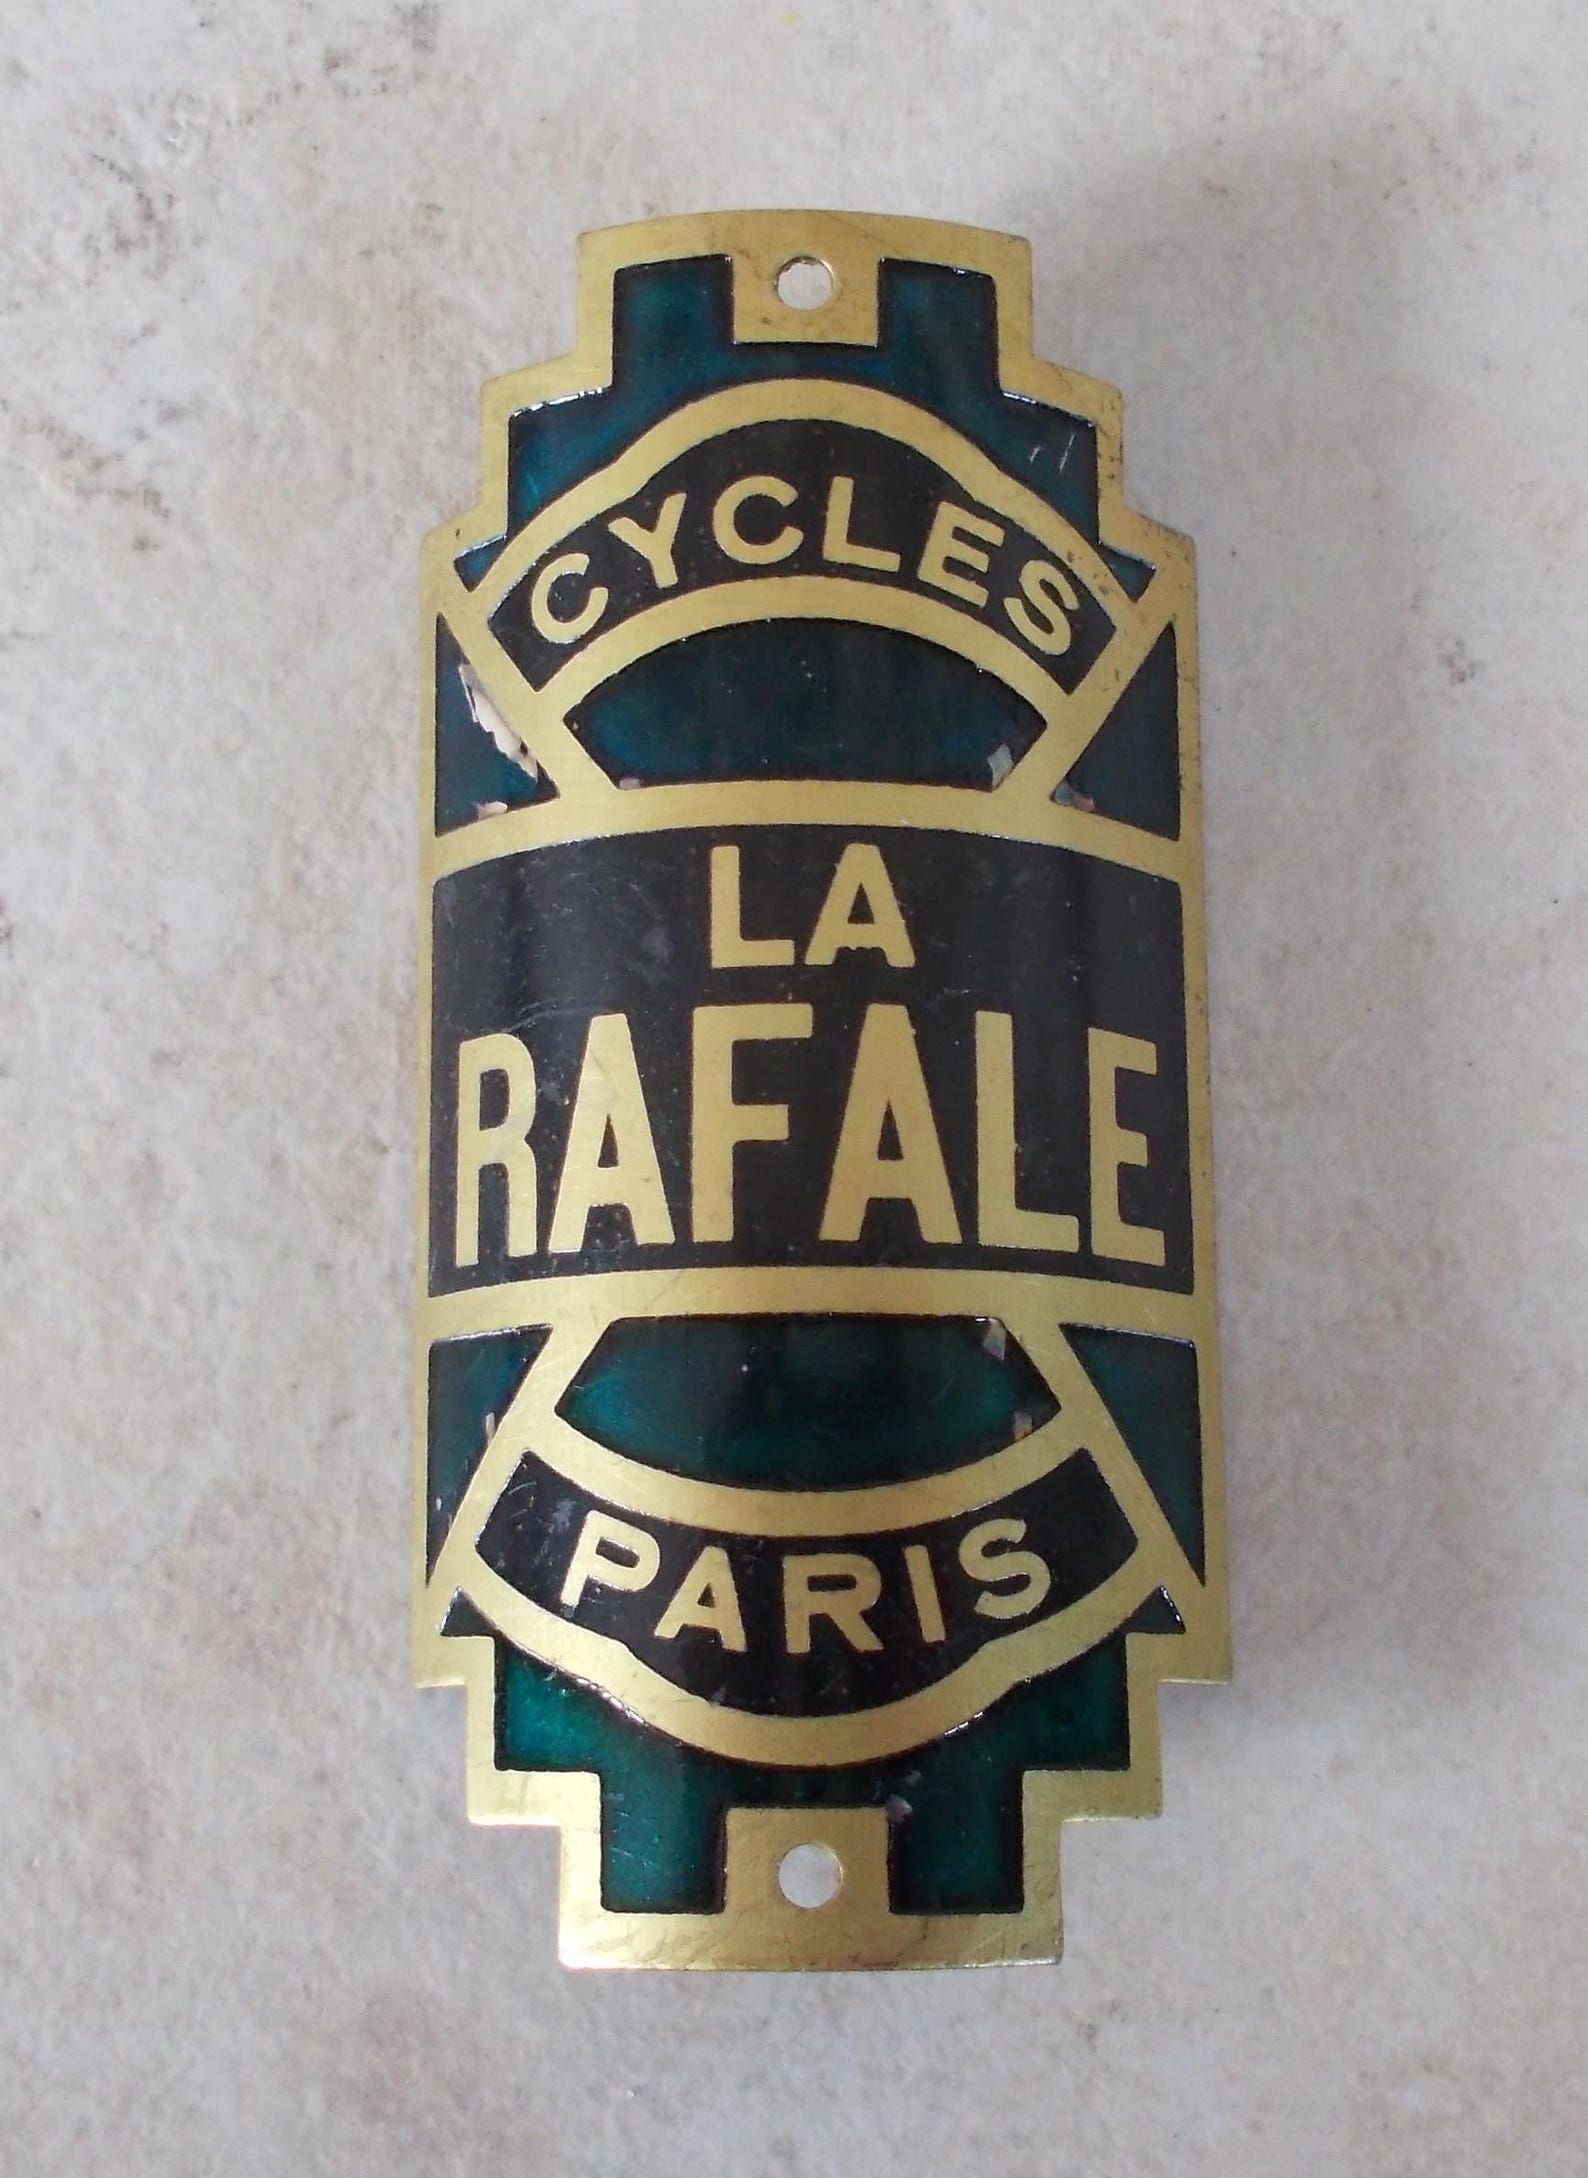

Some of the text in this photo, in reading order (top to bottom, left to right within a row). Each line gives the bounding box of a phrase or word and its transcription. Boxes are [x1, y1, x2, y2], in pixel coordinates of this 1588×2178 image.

[530, 475, 1082, 656] CYCLES
[710, 843, 916, 969] LA
[454, 1003, 1166, 1267] RAFALE
[560, 1509, 1053, 1652] PARIS
